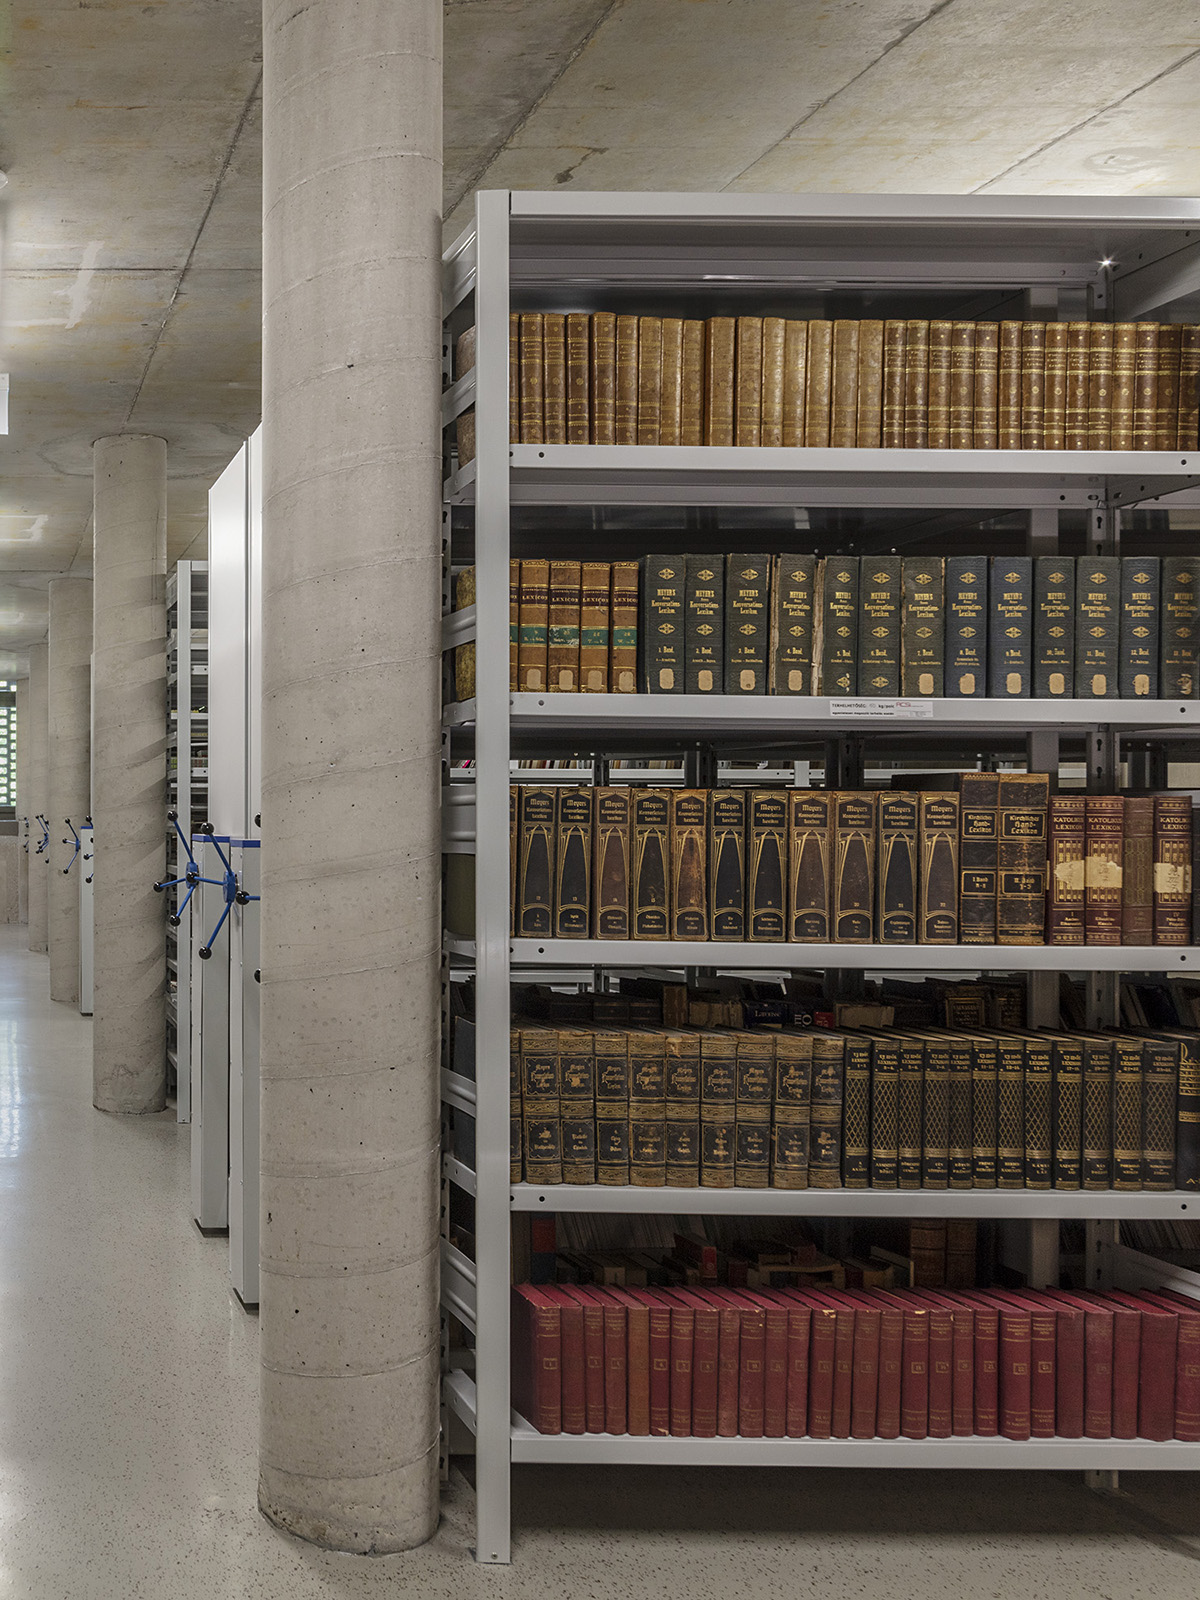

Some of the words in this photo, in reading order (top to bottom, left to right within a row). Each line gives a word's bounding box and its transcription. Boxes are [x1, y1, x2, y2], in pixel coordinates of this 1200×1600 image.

[530, 798, 550, 806] Meyers
[566, 799, 587, 807] Meyers
[605, 800, 625, 808] Meyers
[643, 801, 663, 809] Meyers
[681, 802, 701, 810] Meyers
[719, 802, 740, 810] Meyers
[760, 803, 782, 811] Meyers
[802, 804, 823, 812] Meyers
[846, 805, 868, 813] Meyers
[930, 805, 953, 813] Meyers
